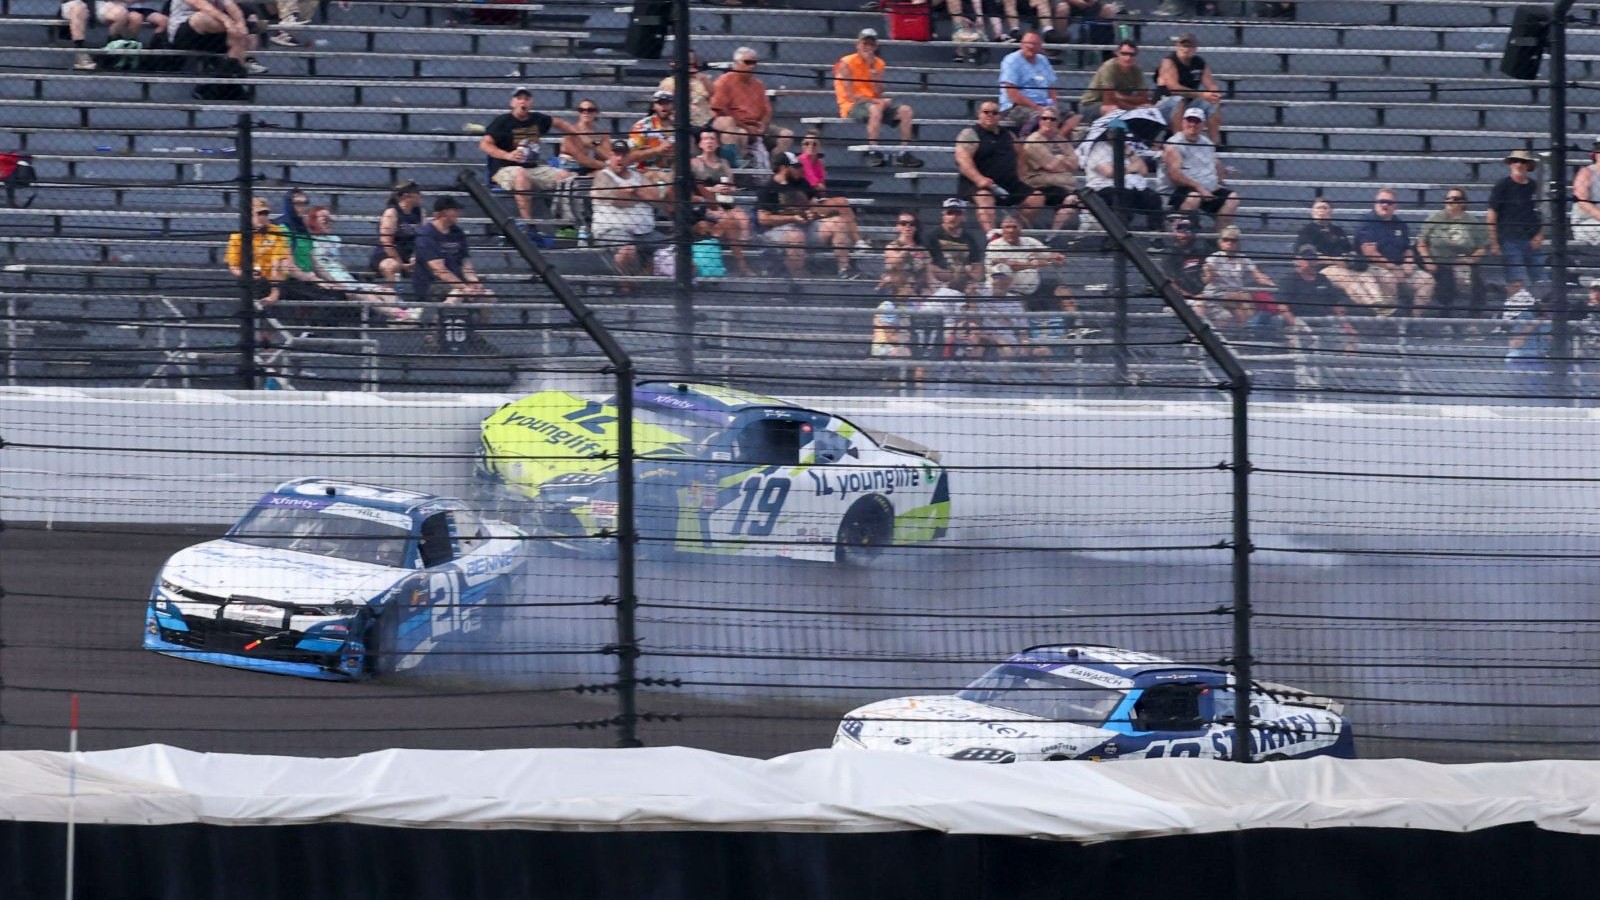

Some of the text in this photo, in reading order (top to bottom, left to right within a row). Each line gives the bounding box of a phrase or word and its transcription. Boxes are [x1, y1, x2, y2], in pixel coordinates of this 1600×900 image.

[654, 393, 695, 410] xfinity
[838, 464, 920, 501] younglife
[270, 496, 319, 510] xfinity
[731, 475, 792, 537] 19
[429, 570, 461, 638] 21
